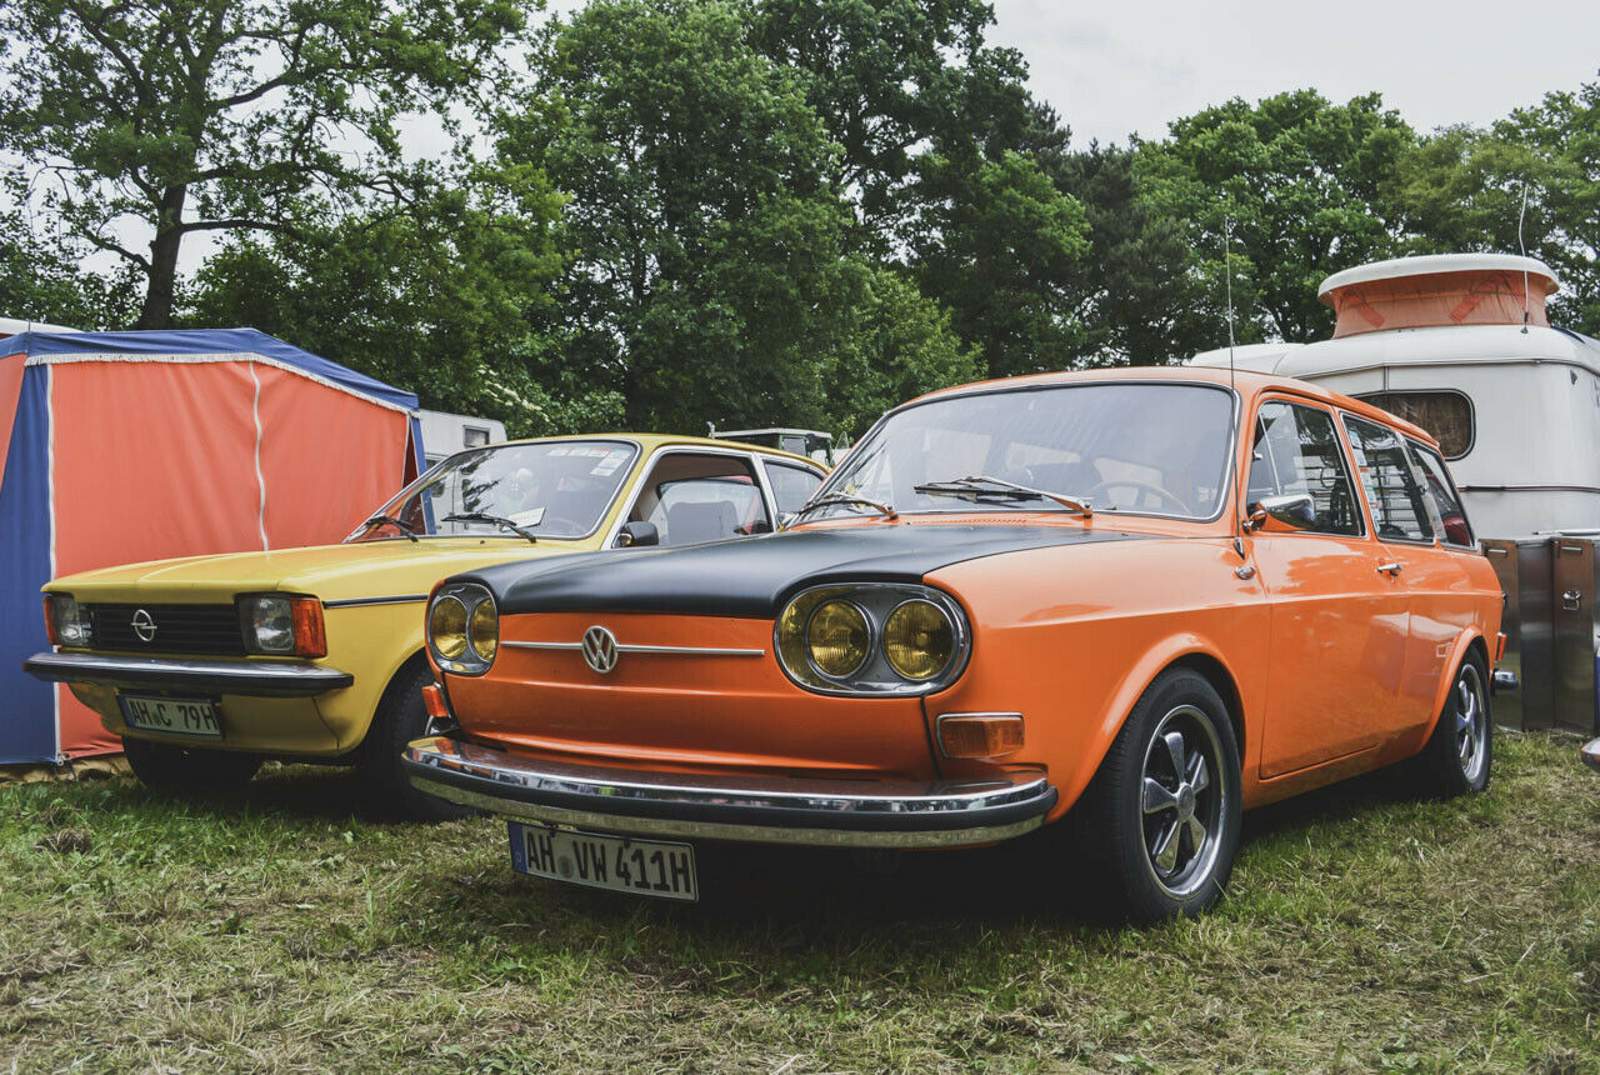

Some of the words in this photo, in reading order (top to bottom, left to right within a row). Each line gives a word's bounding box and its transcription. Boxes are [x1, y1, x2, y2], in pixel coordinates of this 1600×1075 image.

[583, 625, 618, 673] VW
[128, 701, 153, 725] AH
[157, 703, 172, 726] C
[176, 704, 218, 731] 79H
[527, 831, 556, 873] AH
[573, 840, 607, 882] VW
[616, 845, 691, 893] 411H
